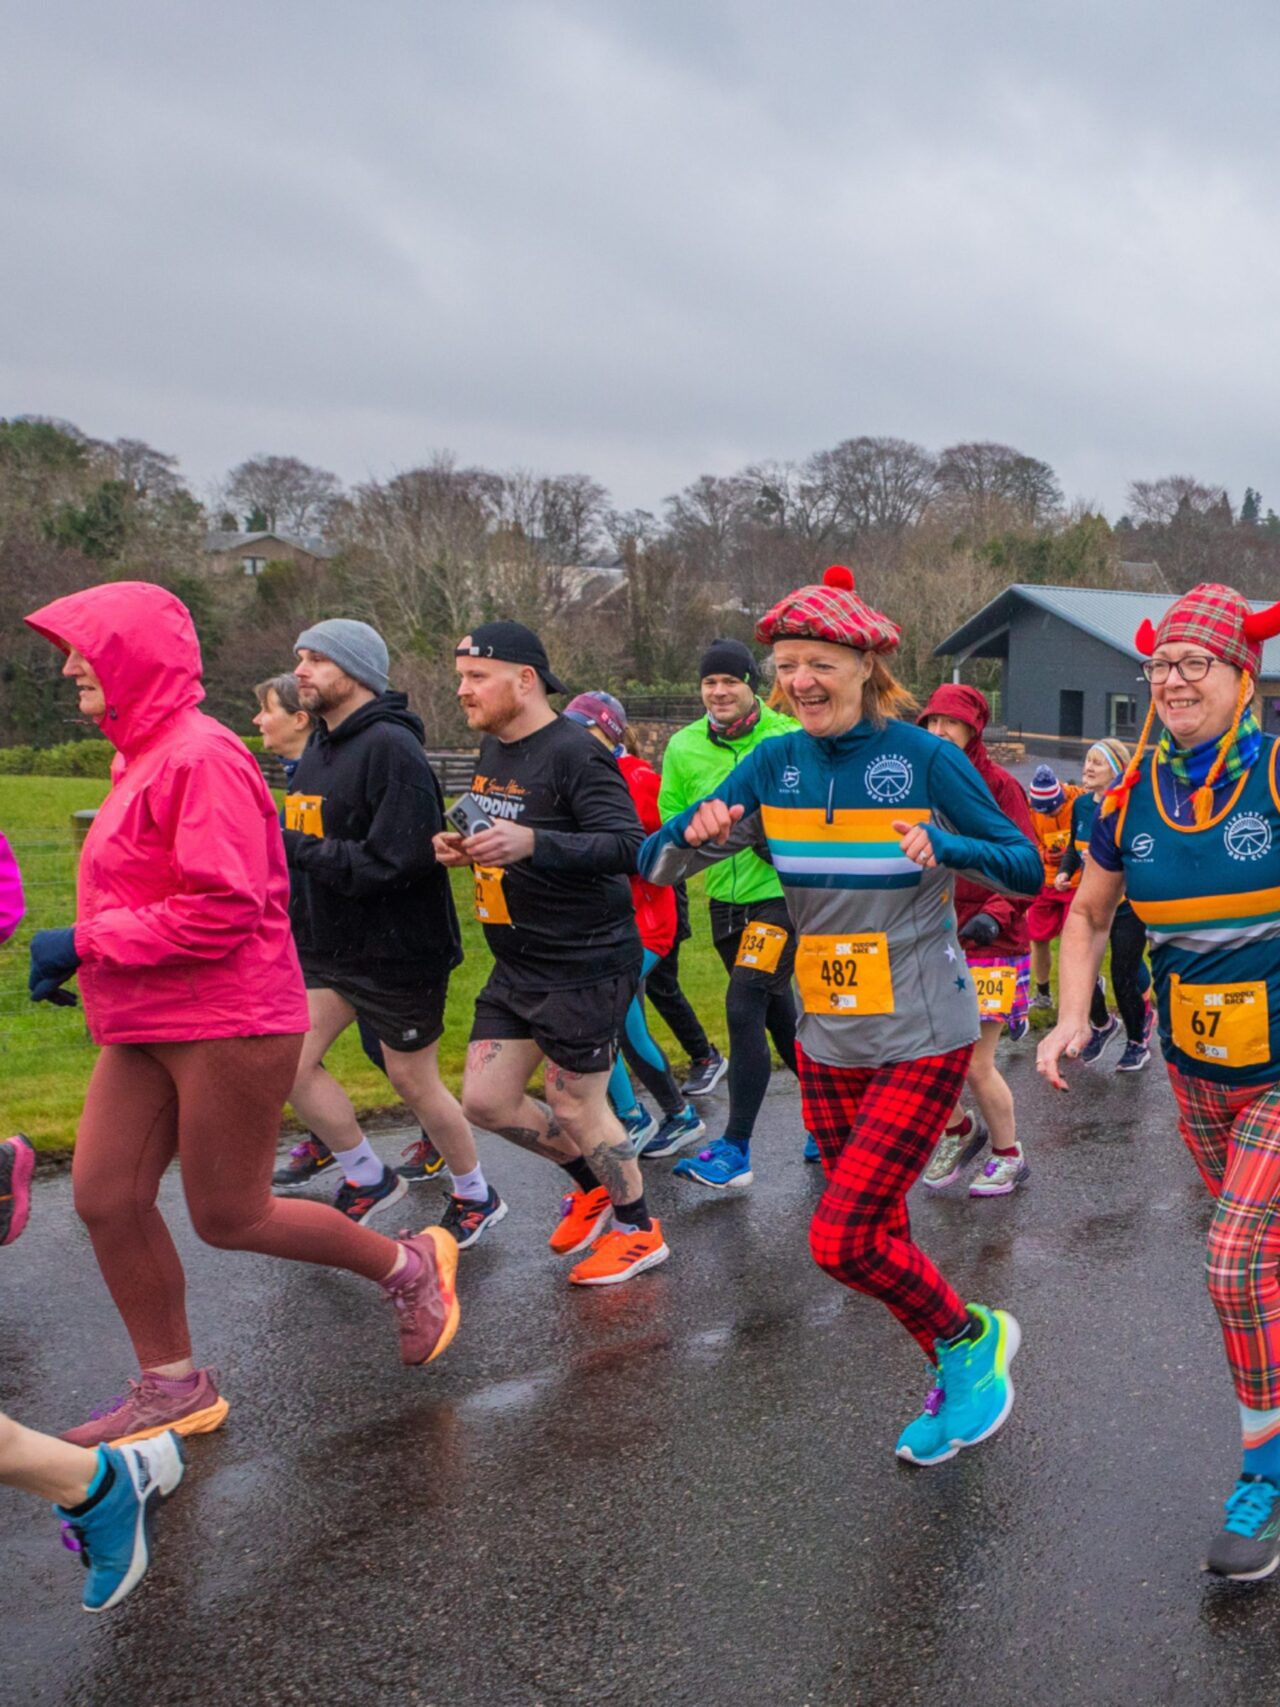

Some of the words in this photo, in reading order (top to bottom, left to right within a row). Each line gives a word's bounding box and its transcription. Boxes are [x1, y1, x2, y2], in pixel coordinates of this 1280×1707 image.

[470, 792, 525, 821] DDIN'
[742, 935, 766, 952] 234
[821, 959, 858, 987] 482
[976, 979, 1004, 996] 204
[1203, 993, 1224, 1006] 5K
[1191, 1010, 1222, 1038] 67
